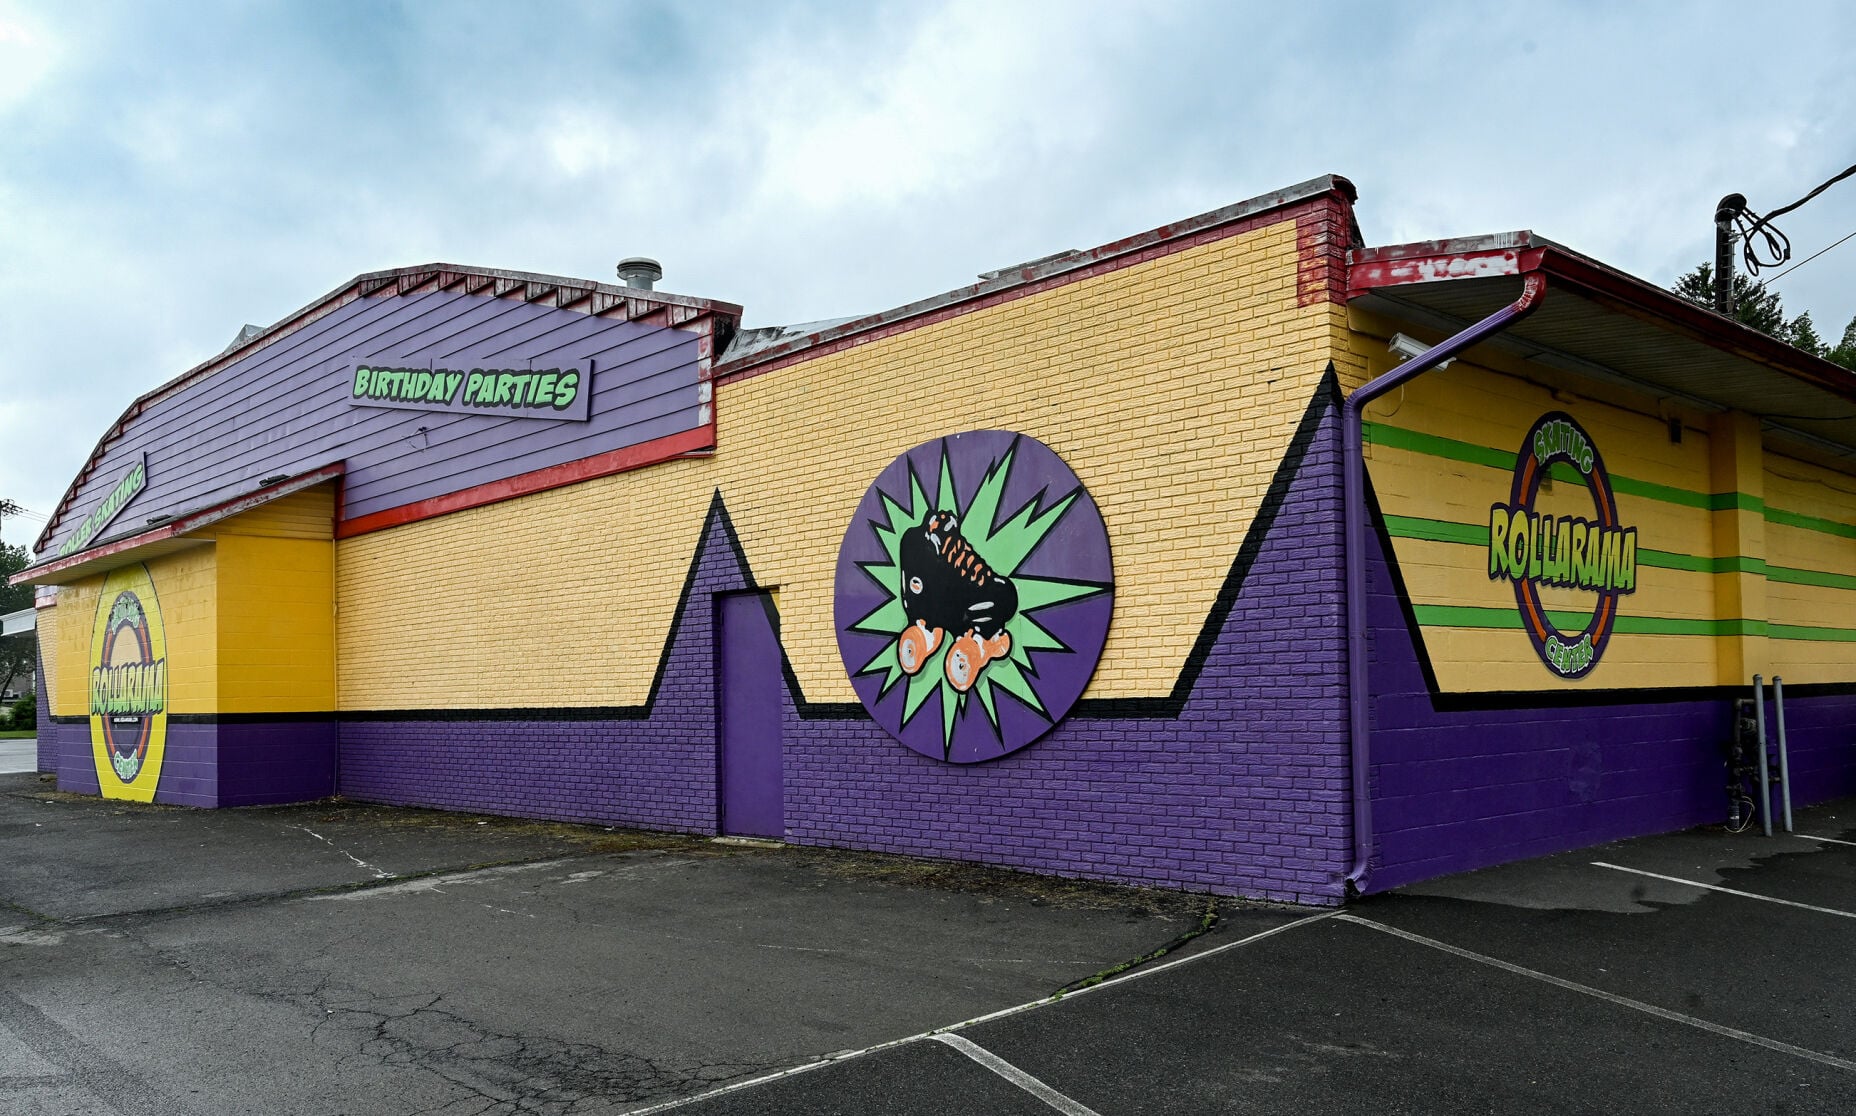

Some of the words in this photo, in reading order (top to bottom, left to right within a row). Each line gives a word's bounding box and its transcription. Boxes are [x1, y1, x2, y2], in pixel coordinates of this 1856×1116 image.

[354, 366, 464, 405] BIRTHDAY
[463, 368, 579, 410] PARTIES
[1534, 419, 1594, 474] SKATING
[94, 463, 143, 529] SKATING
[1490, 504, 1637, 594] ROLLARAMA
[1545, 634, 1594, 674] CENTER
[92, 660, 164, 714] ROLLARAMA
